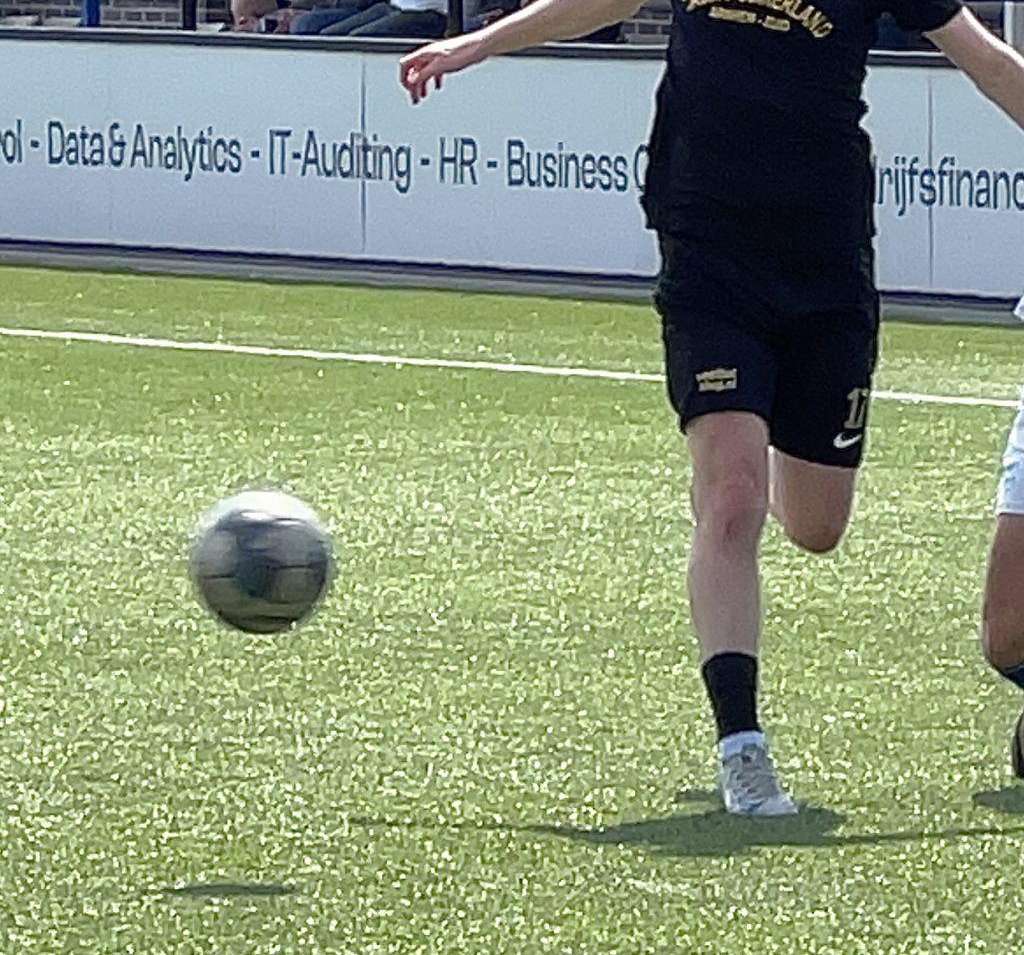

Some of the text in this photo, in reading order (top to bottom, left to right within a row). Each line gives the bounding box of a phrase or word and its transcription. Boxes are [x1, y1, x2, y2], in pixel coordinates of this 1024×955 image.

[0, 118, 22, 164] ol
[48, 120, 104, 166] Data
[109, 122, 126, 167] &
[130, 124, 242, 182] Analytics
[269, 129, 412, 194] IT-Auditing
[440, 136, 478, 186] HR
[507, 139, 629, 192] Business
